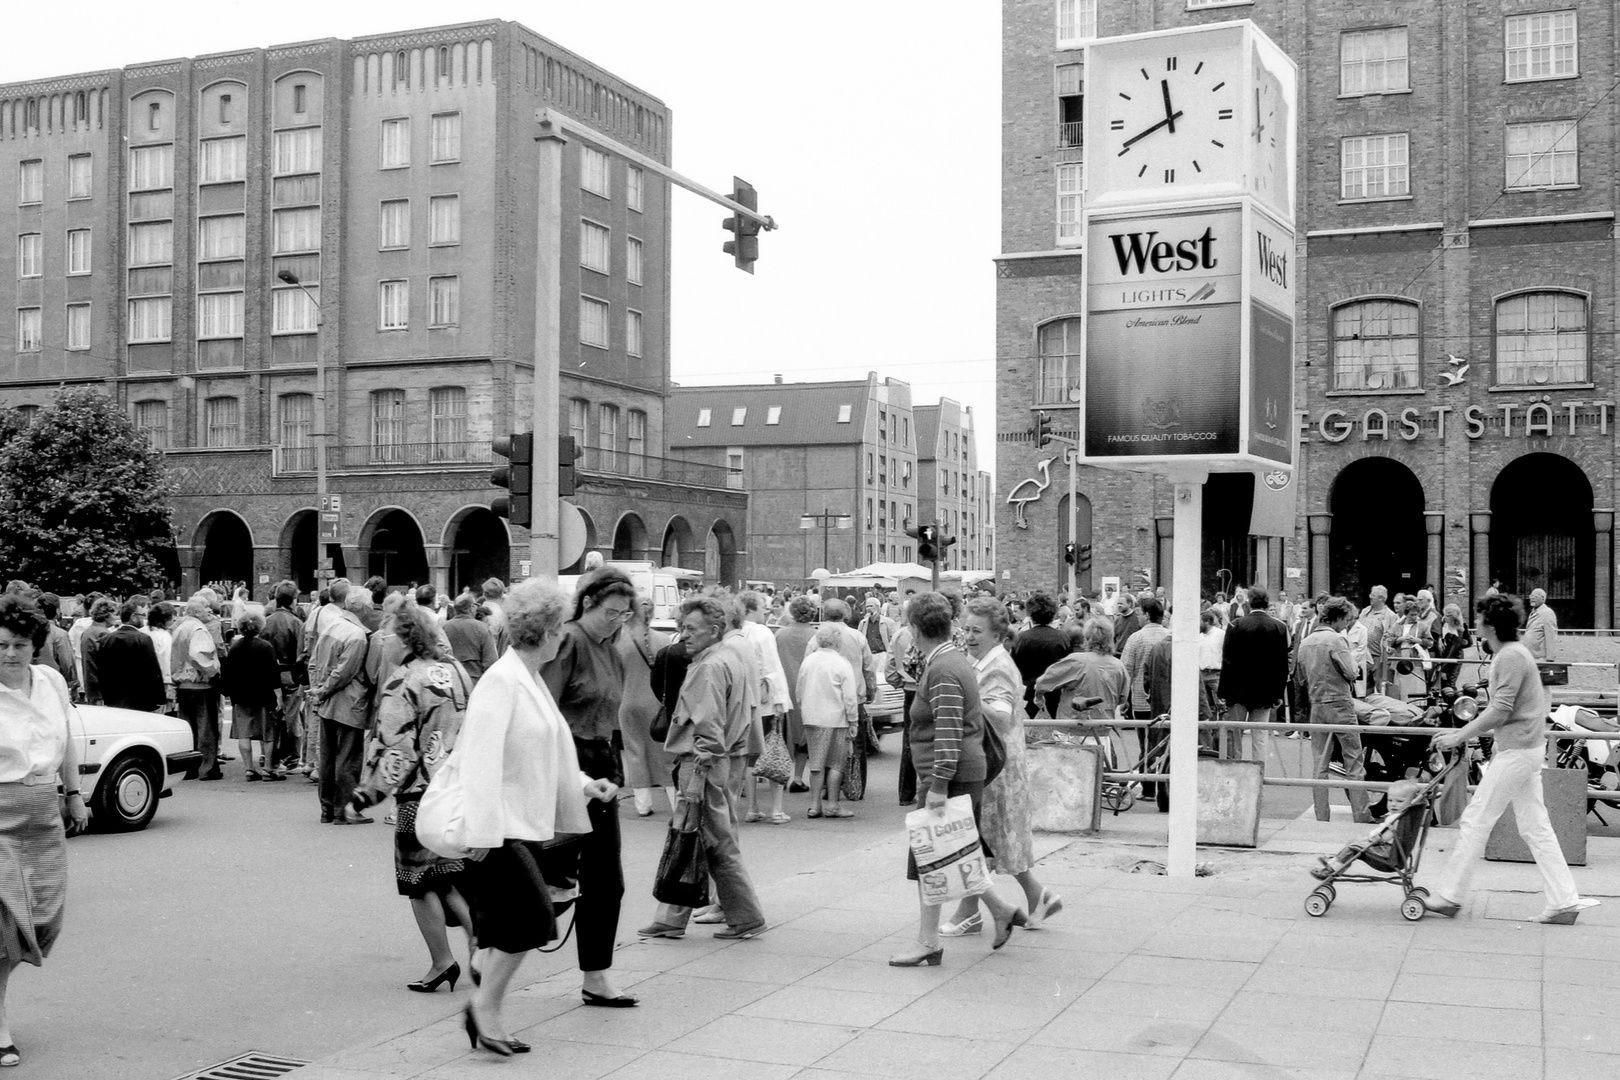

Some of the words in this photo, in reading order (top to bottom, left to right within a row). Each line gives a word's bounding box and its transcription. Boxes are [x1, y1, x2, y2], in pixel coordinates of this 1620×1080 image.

[1108, 226, 1217, 276] West
[1256, 230, 1287, 289] West
[1122, 288, 1186, 303] LIGHTS
[1126, 317, 1169, 328] American
[1170, 314, 1202, 326] Blend
[1108, 434, 1139, 443] FAMOUS
[1141, 433, 1173, 442] QUALITY
[1173, 432, 1217, 441] TOBACCOS
[321, 497, 328, 510] P
